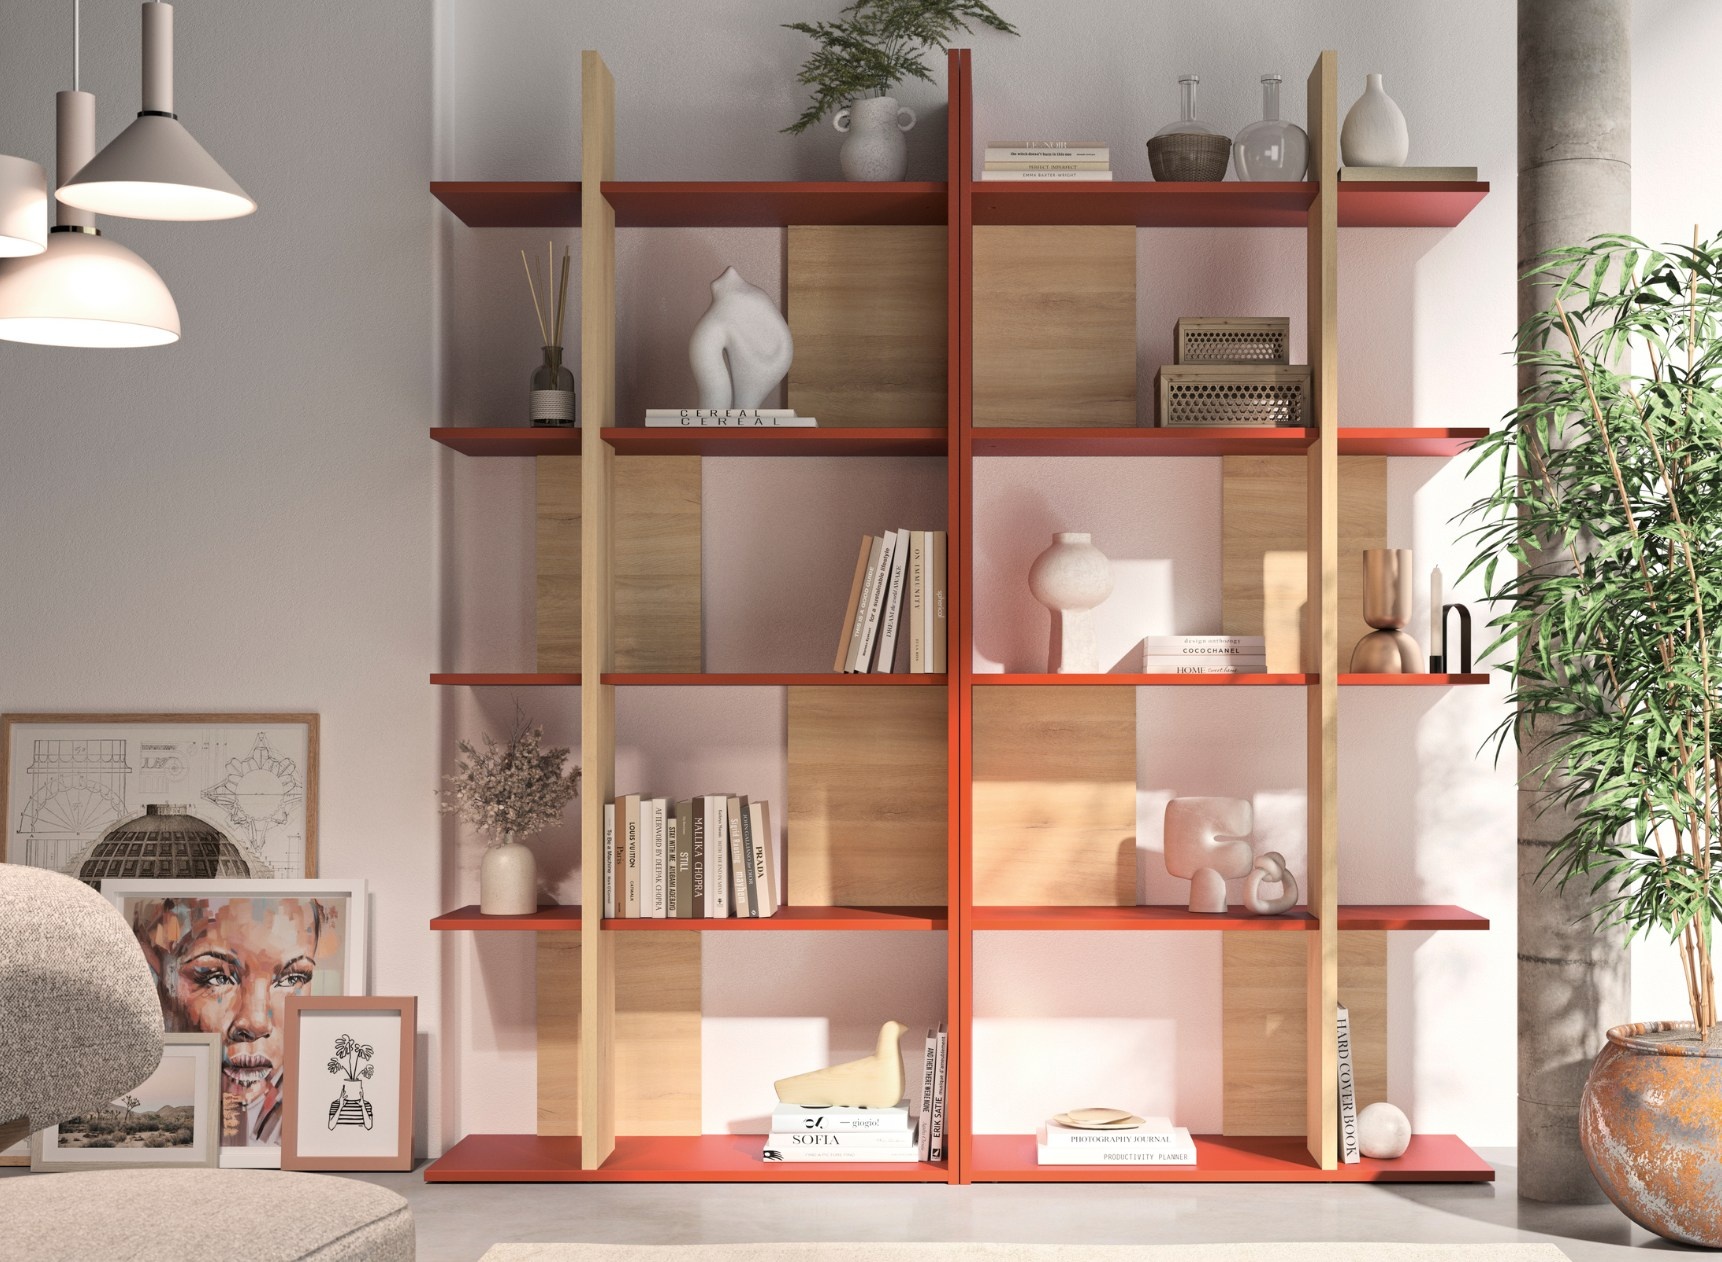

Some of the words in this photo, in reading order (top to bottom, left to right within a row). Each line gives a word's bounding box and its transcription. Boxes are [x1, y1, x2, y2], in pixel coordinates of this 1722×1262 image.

[914, 549, 920, 562] ON
[861, 588, 869, 608] GOOD
[865, 567, 874, 587] GUIDE
[872, 572, 885, 608] sustainable
[879, 548, 890, 571] lifestyle
[886, 611, 895, 638] DREAM
[893, 565, 902, 590] AWAKE
[936, 590, 945, 618] spherical
[607, 837, 612, 845] Be
[694, 817, 703, 857] MALLIKA
[730, 818, 739, 837] Sigrid
[656, 849, 662, 857] BY
[669, 854, 675, 862] ME
[744, 832, 752, 861] GALLIANO
[680, 852, 688, 872] STILL
[756, 846, 764, 879] PRADA
[694, 862, 703, 898] CHOPRA
[735, 871, 746, 904] mayhem
[1337, 1019, 1349, 1059] HARD
[1339, 1063, 1354, 1111] COVER
[934, 1097, 942, 1118] SATIE
[853, 1119, 880, 1128] giogio!
[1344, 1115, 1357, 1156] BOOK
[793, 1135, 840, 1145] SOFIA
